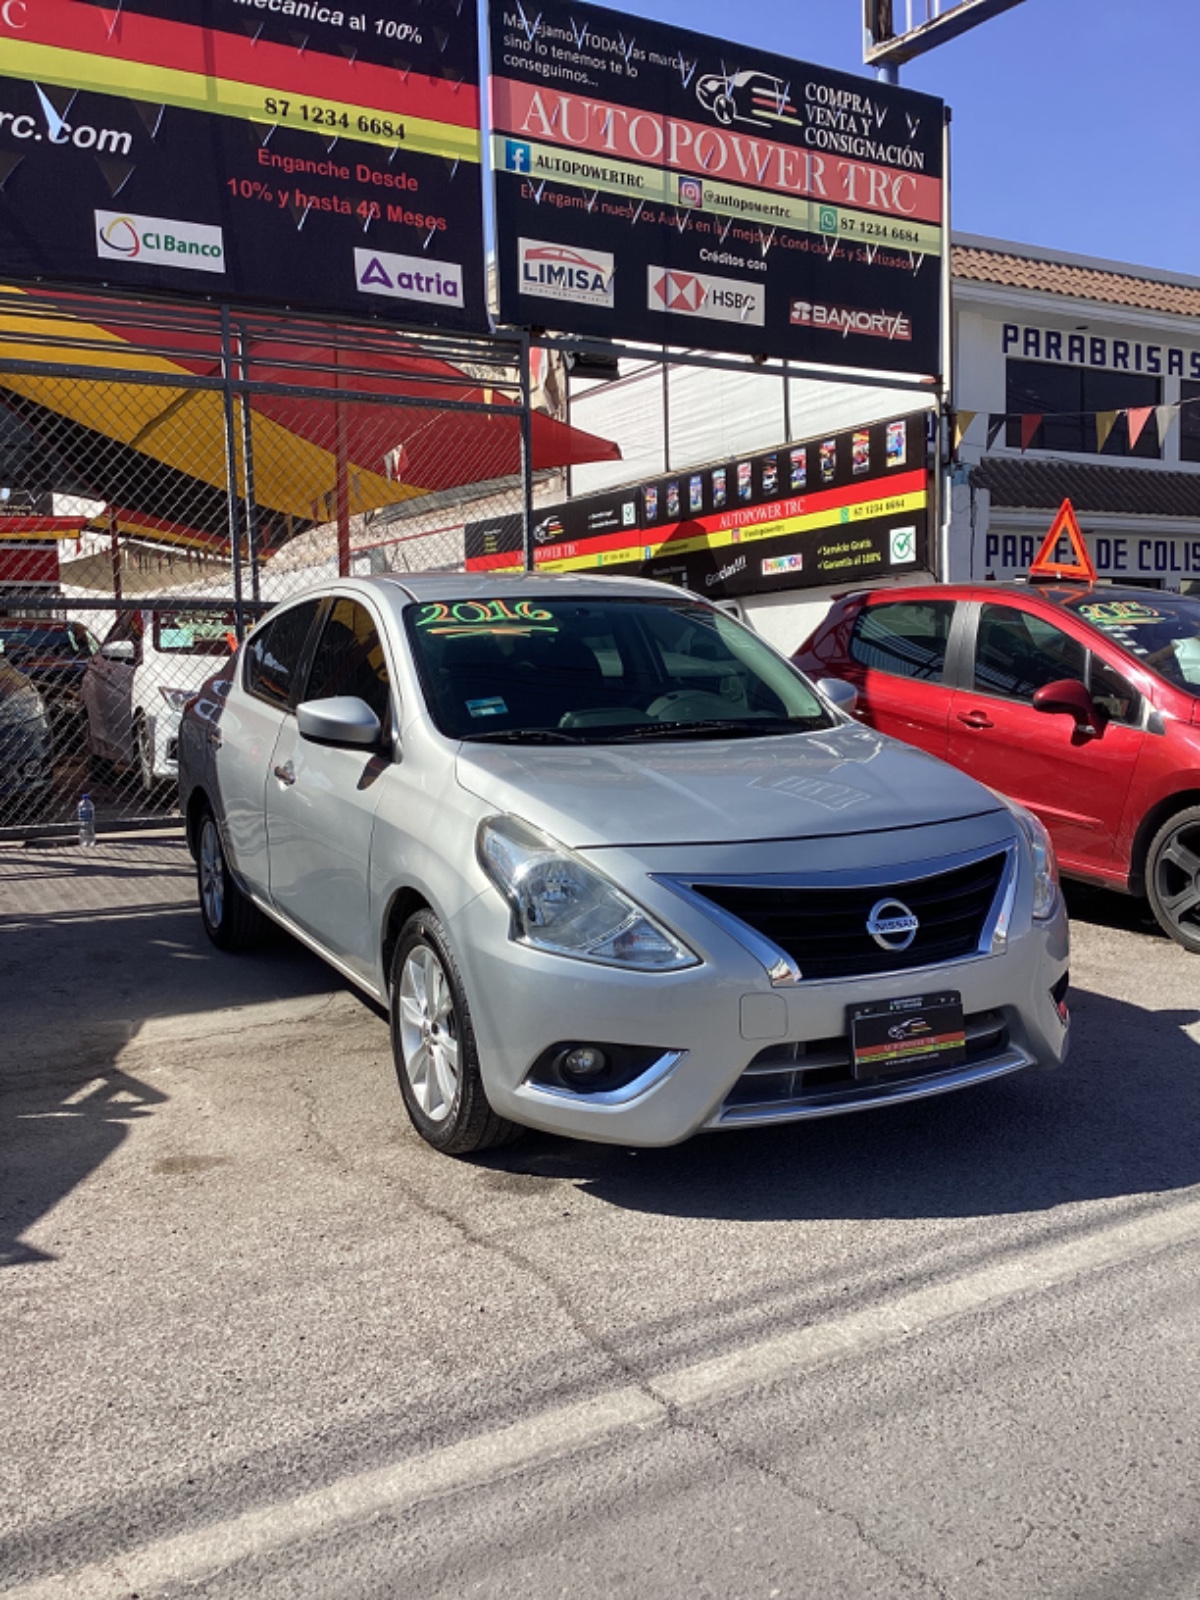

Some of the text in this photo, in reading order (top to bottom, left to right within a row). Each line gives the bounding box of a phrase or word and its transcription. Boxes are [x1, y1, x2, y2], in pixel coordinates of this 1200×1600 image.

[349, 14, 366, 32] al
[375, 19, 422, 44] 100%
[504, 34, 638, 78] sino lo tenemos te lo
[630, 46, 646, 61] as
[805, 82, 873, 117] COMPRA
[265, 98, 405, 140] 87 1234 6684
[805, 104, 873, 136] VENTA Y
[519, 90, 916, 214] AUTOPOWER TRC
[805, 127, 924, 170] CONSIGNACIÓN
[258, 149, 418, 191] Enganche Desde
[535, 155, 645, 188] AUTOPOWERTRC
[227, 178, 447, 230] 10% y hasta 48 Meses
[521, 184, 599, 212] Enregamos
[696, 220, 710, 233] en
[704, 190, 791, 218] @autopowertrc
[840, 217, 855, 231] 87
[860, 221, 887, 238] 1234
[699, 247, 767, 271] Créditos con
[398, 272, 458, 297] atria
[523, 263, 607, 292] LIMISA
[713, 290, 755, 311] HSBC
[812, 306, 910, 336] BANORTE
[1002, 323, 1200, 378] PARABRISAS
[720, 500, 804, 528] AUTOPOWER TRC
[986, 534, 1200, 572] PARE DE COLIS
[416, 600, 553, 626] 2016
[875, 918, 917, 931] NISSAN
